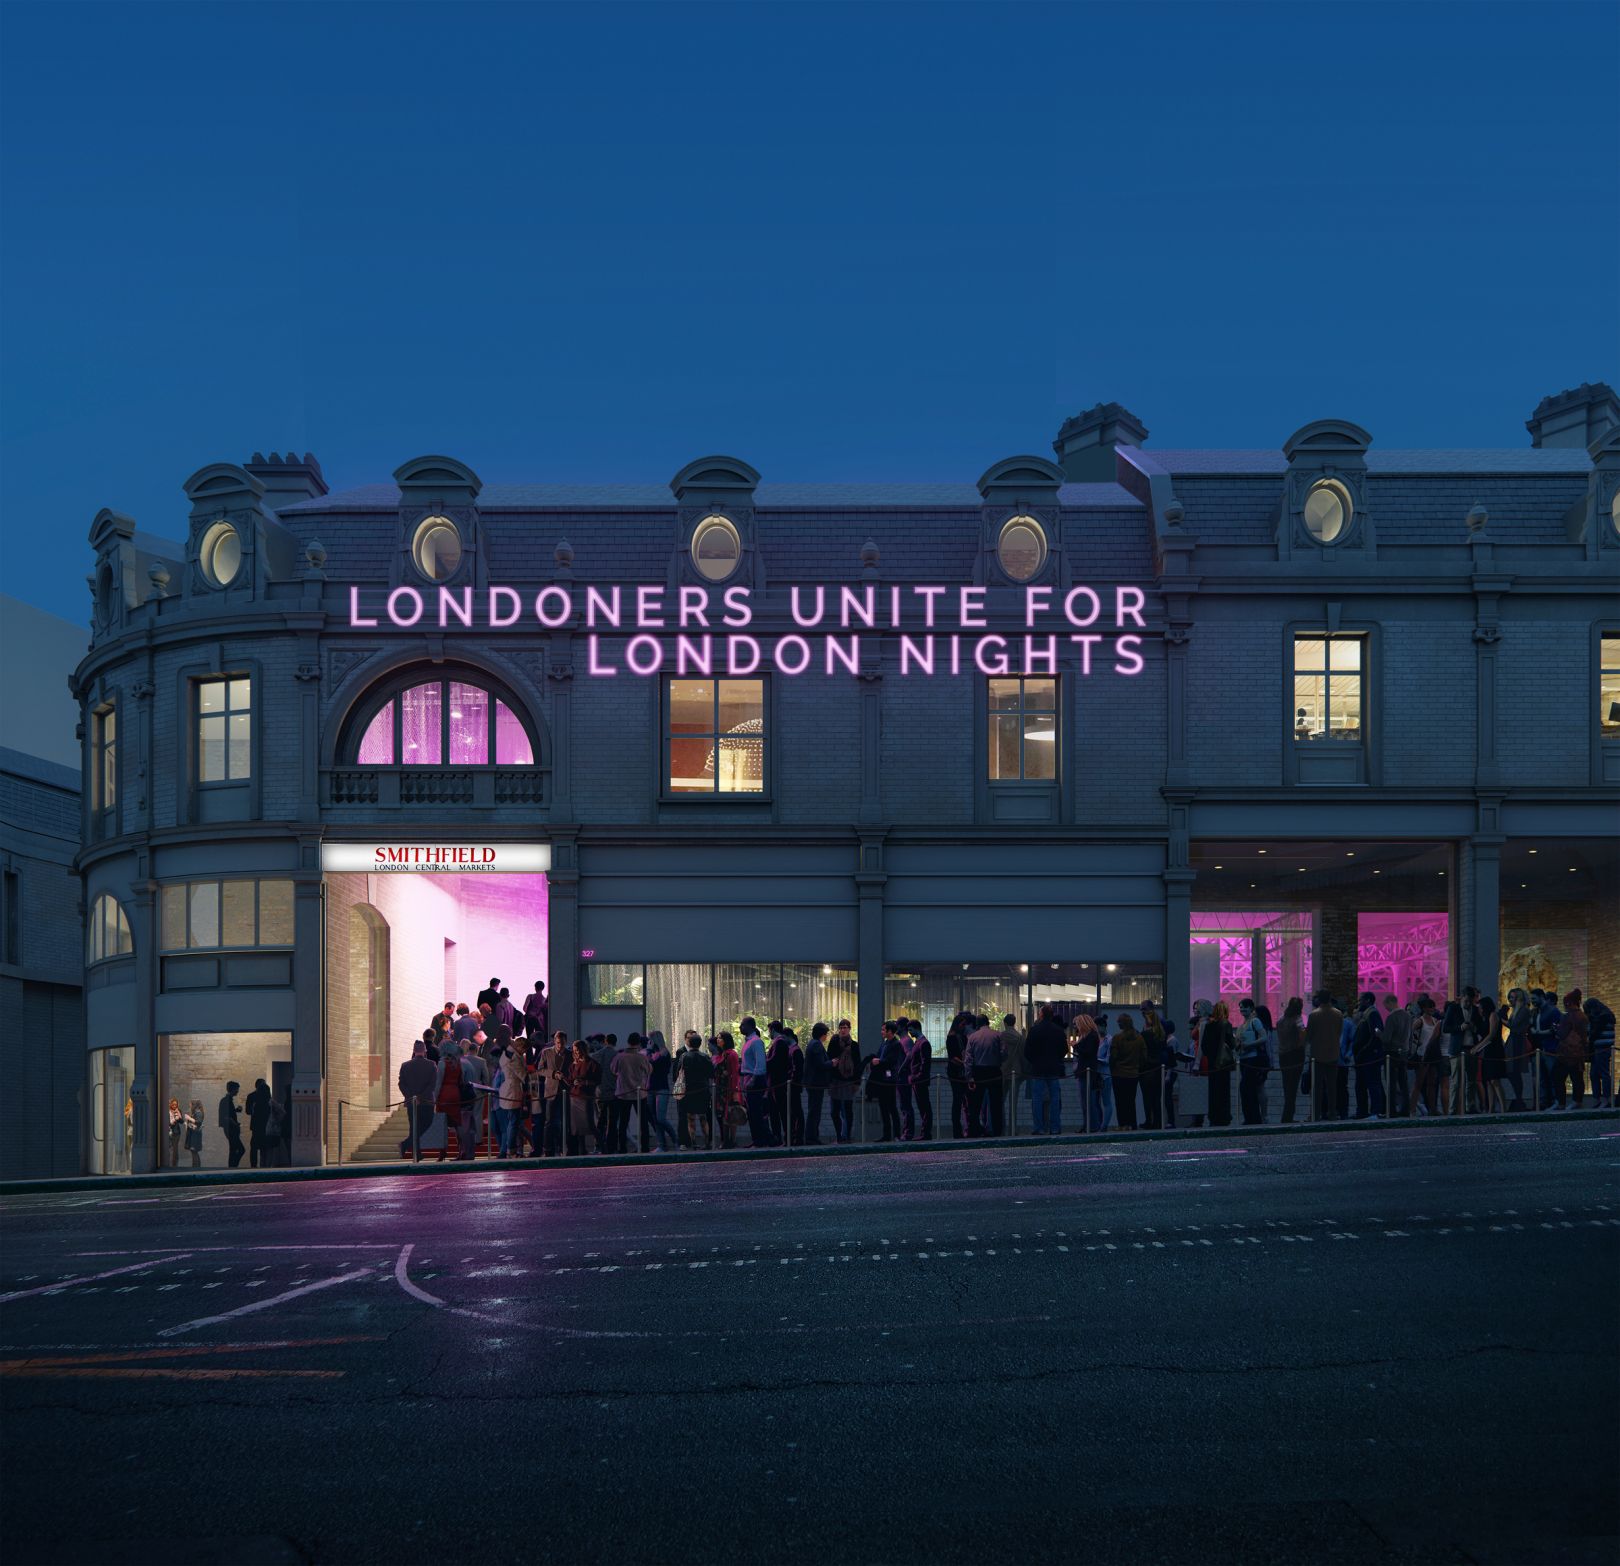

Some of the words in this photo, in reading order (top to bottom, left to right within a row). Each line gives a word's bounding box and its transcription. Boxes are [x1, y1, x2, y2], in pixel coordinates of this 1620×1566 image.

[349, 586, 753, 627] LONDONERS
[791, 586, 987, 627] UNITE
[1026, 586, 1146, 627] FOR
[588, 634, 860, 676] LONDON
[901, 634, 1145, 676] NIGHTS
[374, 847, 496, 863] SMITHFIELD
